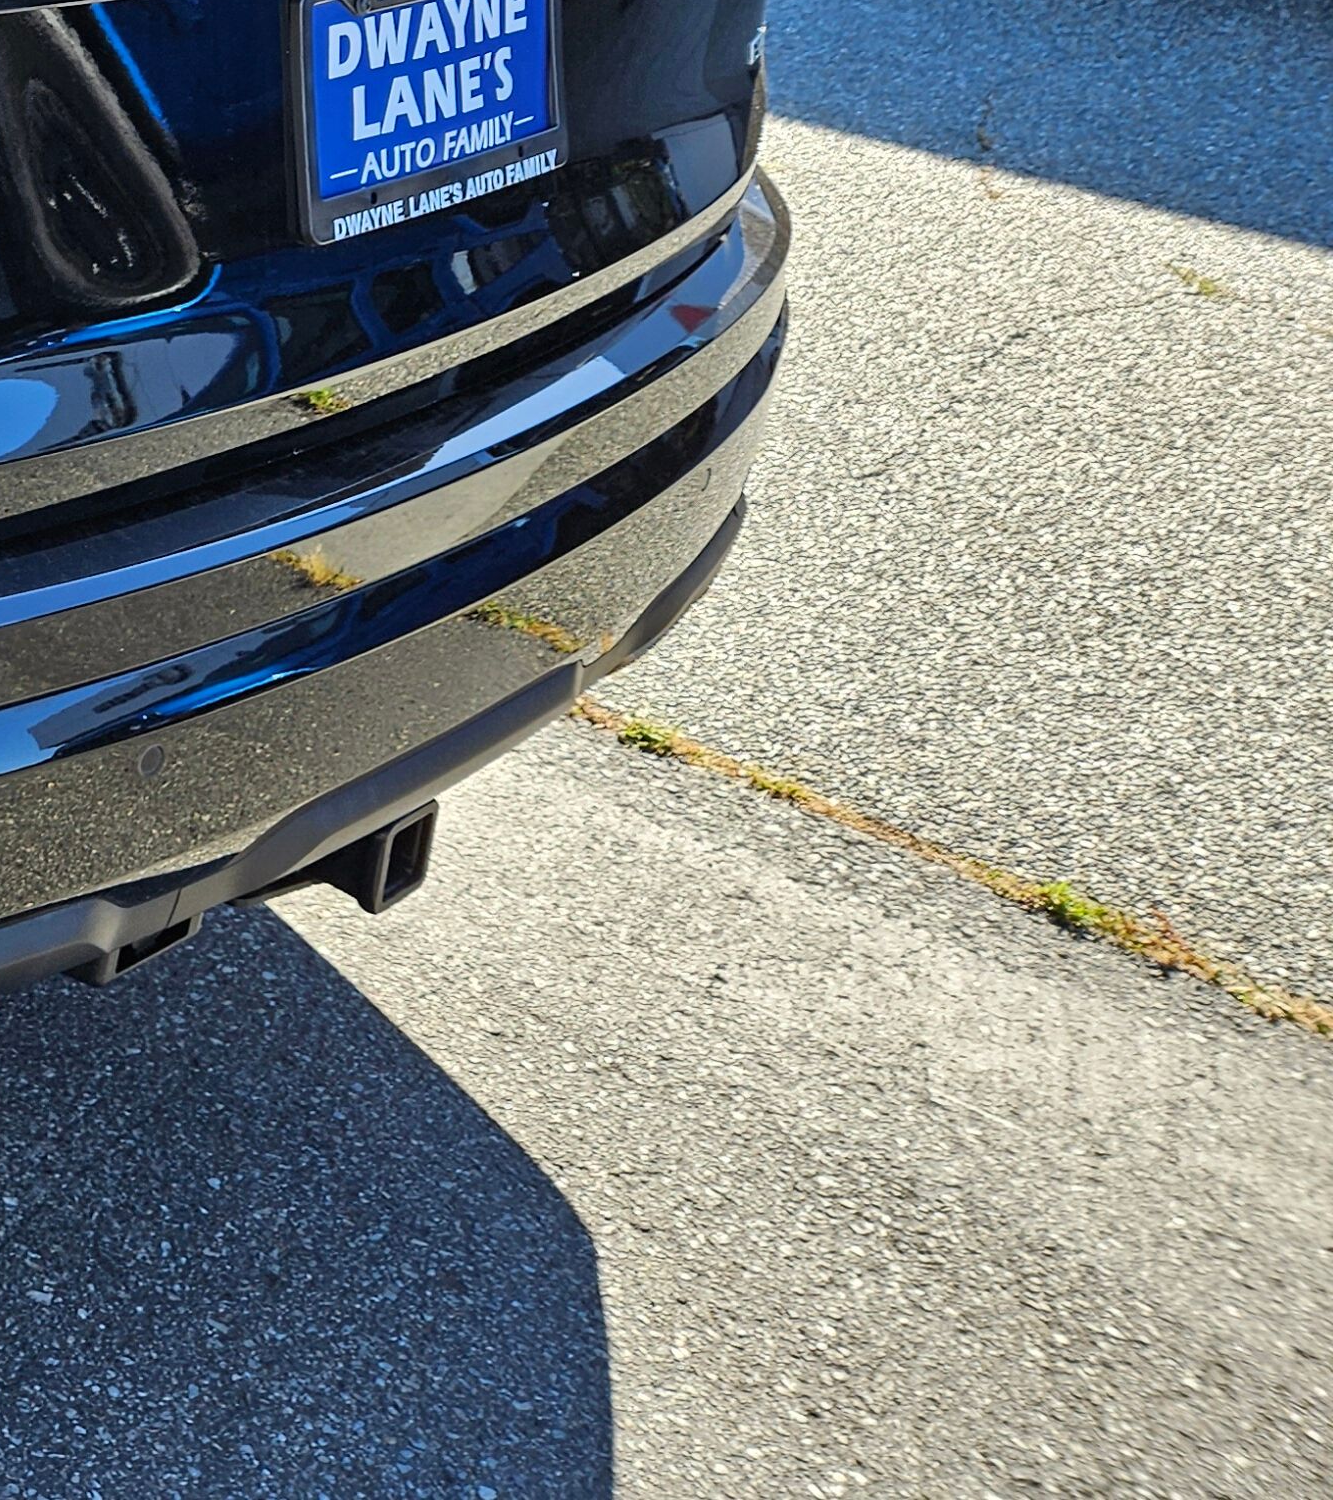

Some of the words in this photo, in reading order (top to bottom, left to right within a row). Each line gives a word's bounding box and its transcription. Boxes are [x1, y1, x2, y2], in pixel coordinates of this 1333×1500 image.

[352, 46, 514, 141] LANE'S
[360, 137, 435, 184] AUTO
[443, 111, 515, 161] FAMILY
[333, 201, 406, 241] DWAYNE
[409, 182, 463, 217] LANE'S
[465, 168, 504, 200] AUTO
[505, 148, 558, 185] FAMILY
